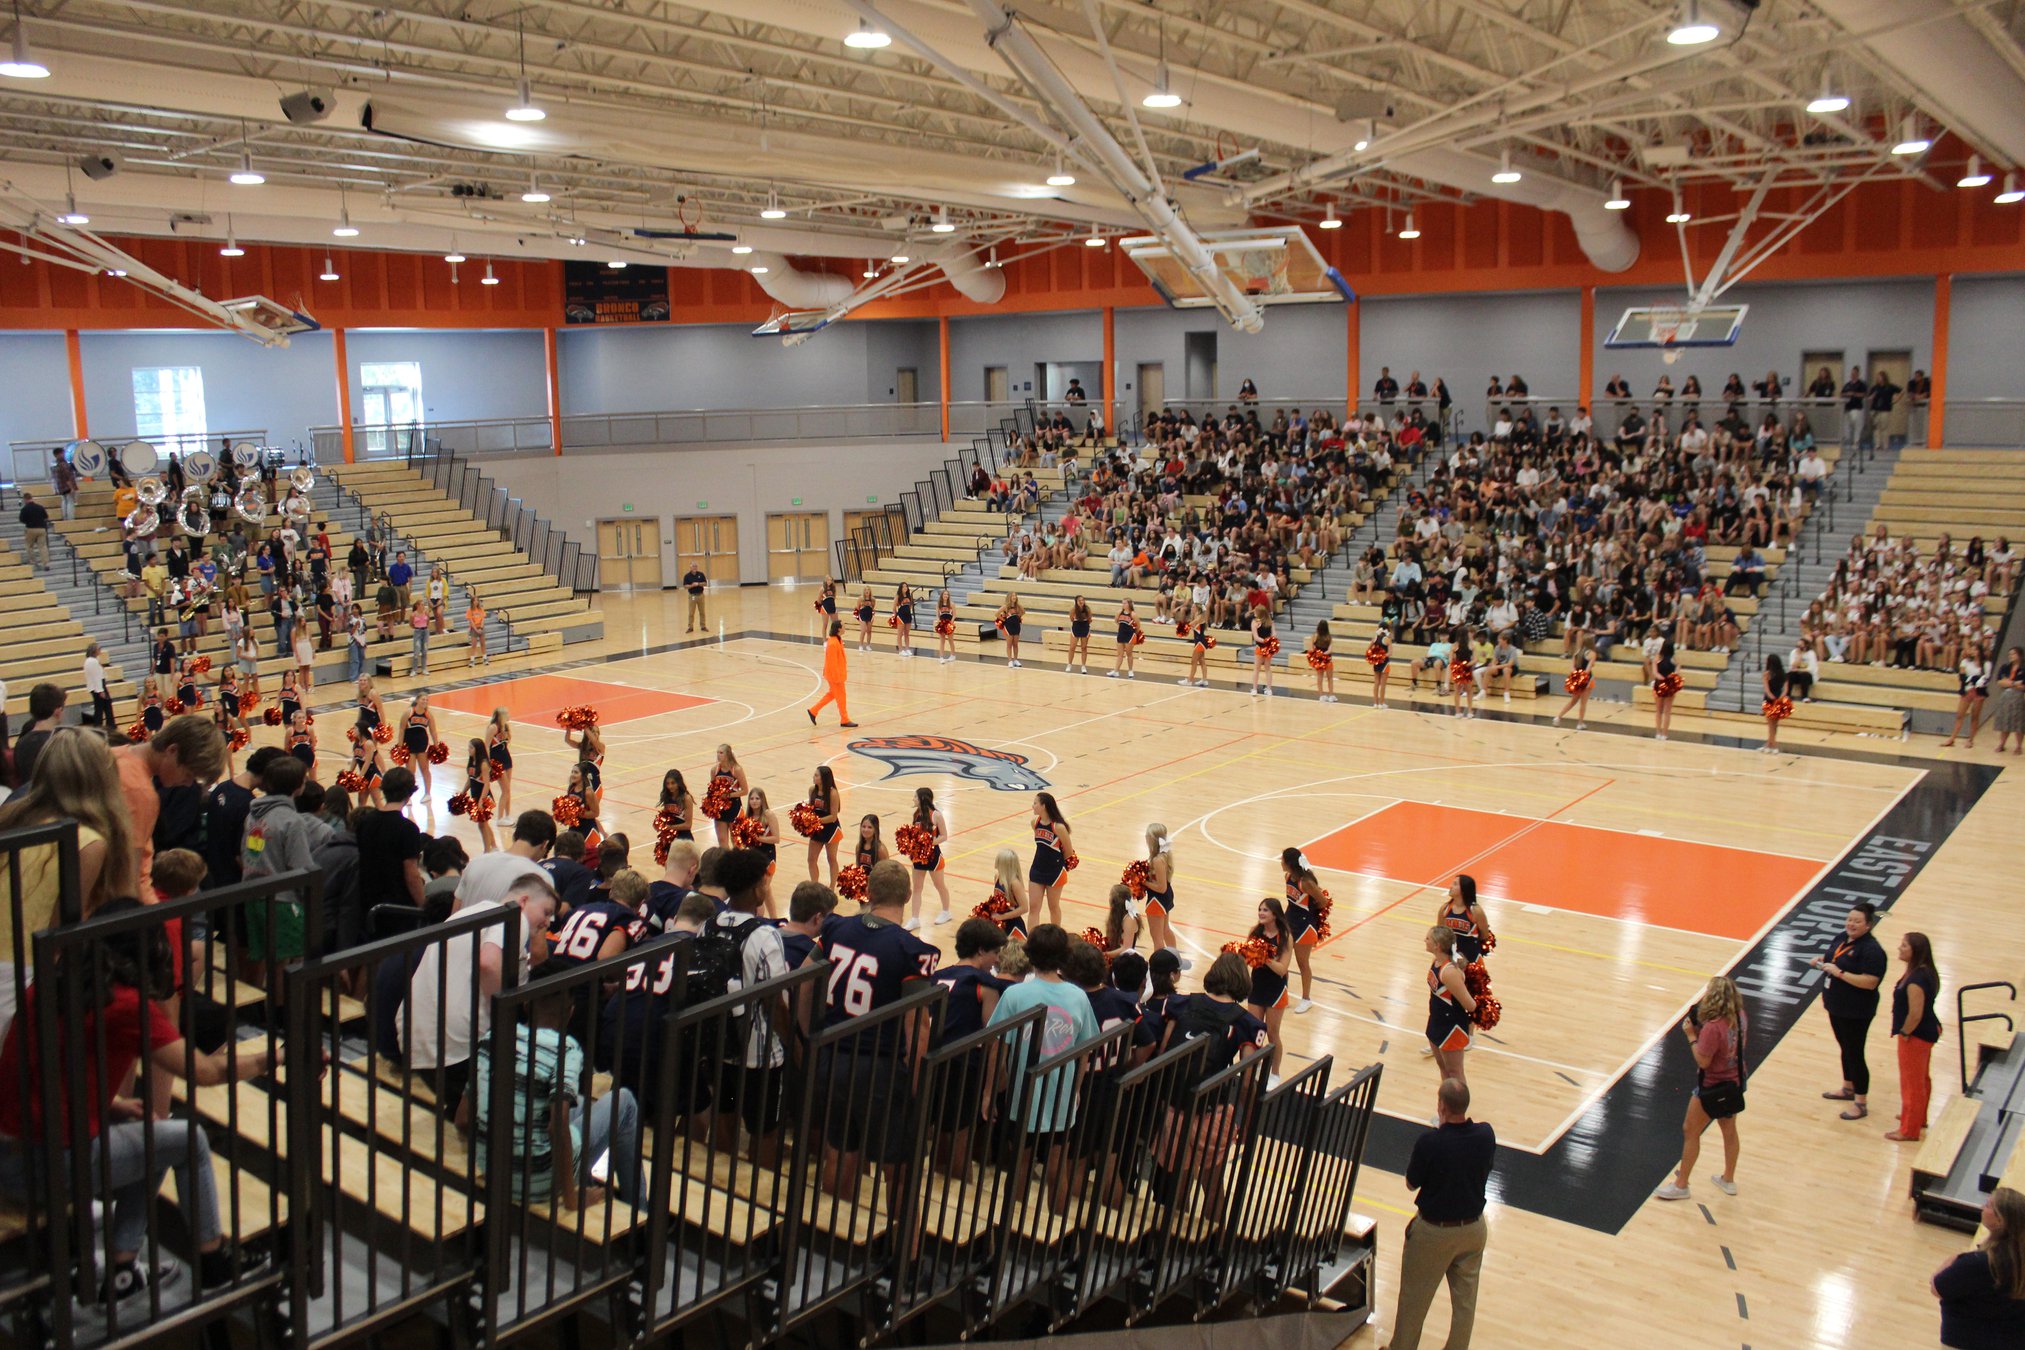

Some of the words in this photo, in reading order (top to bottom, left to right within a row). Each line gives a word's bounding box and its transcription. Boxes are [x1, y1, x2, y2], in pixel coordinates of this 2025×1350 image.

[595, 302, 639, 314] BRONCO
[1839, 835, 1933, 888] EAST
[553, 910, 608, 960] 46
[1736, 886, 1888, 1005] FORSYTH
[826, 943, 879, 1017] 76
[918, 953, 939, 976] 76
